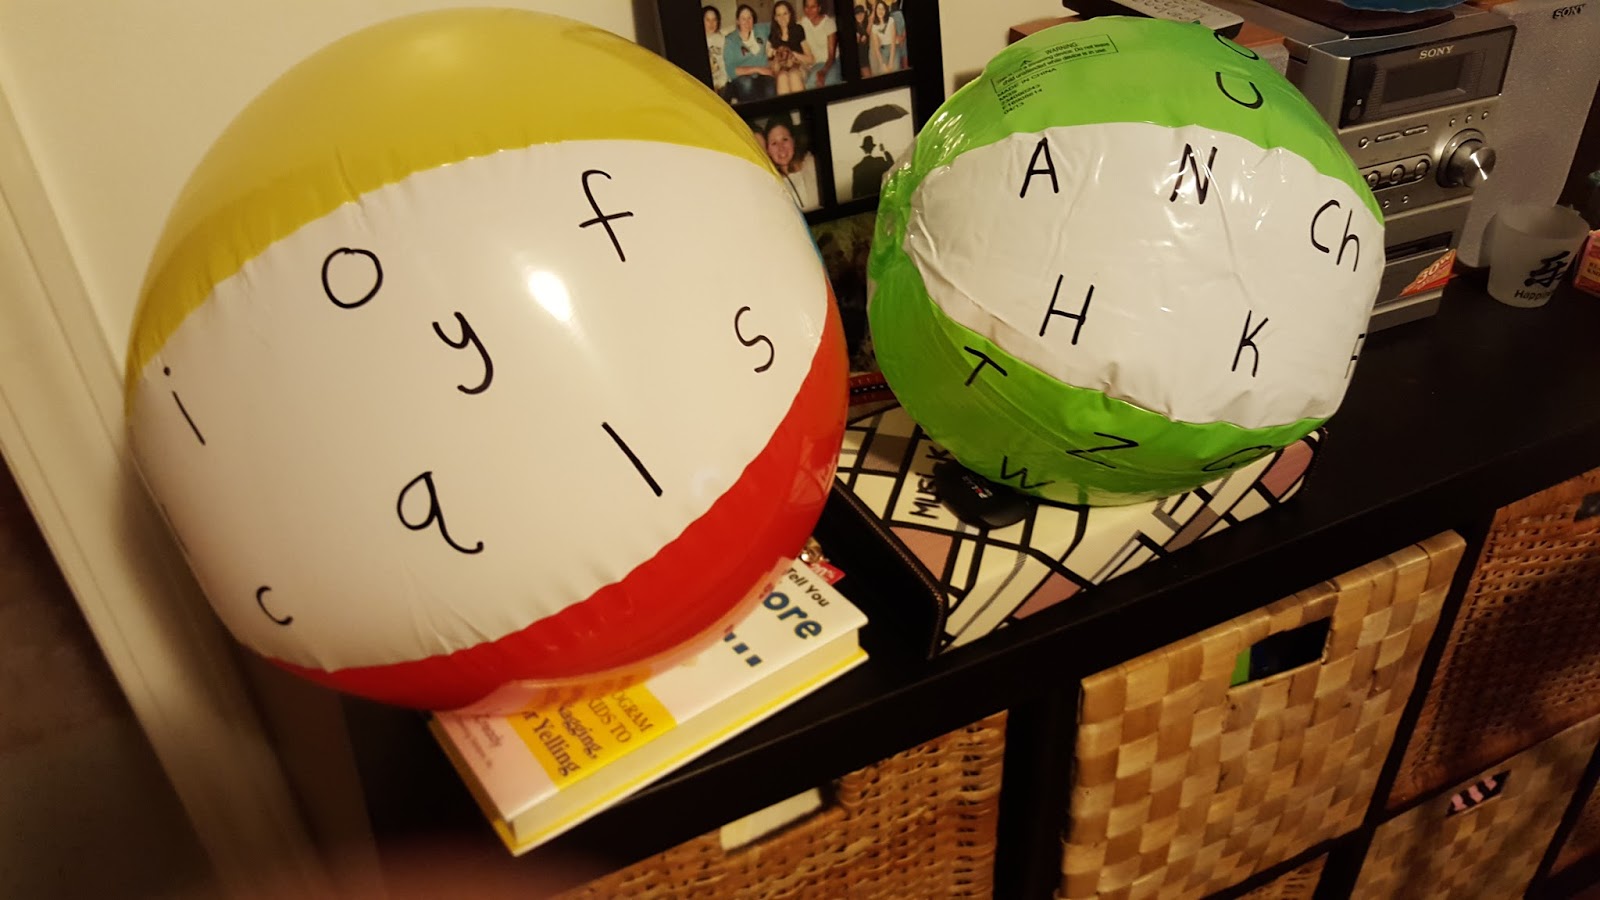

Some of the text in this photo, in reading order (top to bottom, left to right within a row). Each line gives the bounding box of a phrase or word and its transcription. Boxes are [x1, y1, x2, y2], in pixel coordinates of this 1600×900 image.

[1552, 3, 1587, 19] SONY
[1419, 45, 1455, 60] SONY
[1019, 136, 1060, 199] A
[1170, 143, 1218, 205] N
[1310, 199, 1360, 272] Ch
[1038, 274, 1095, 346] H
[963, 345, 1008, 387] T
[1231, 309, 1269, 378] K
[1066, 431, 1140, 469] Z
[786, 567, 830, 608] Tell You
[763, 591, 823, 641] ore
[610, 724, 632, 745] TO
[612, 690, 654, 733] OGRAM
[533, 717, 581, 777] Yelling
